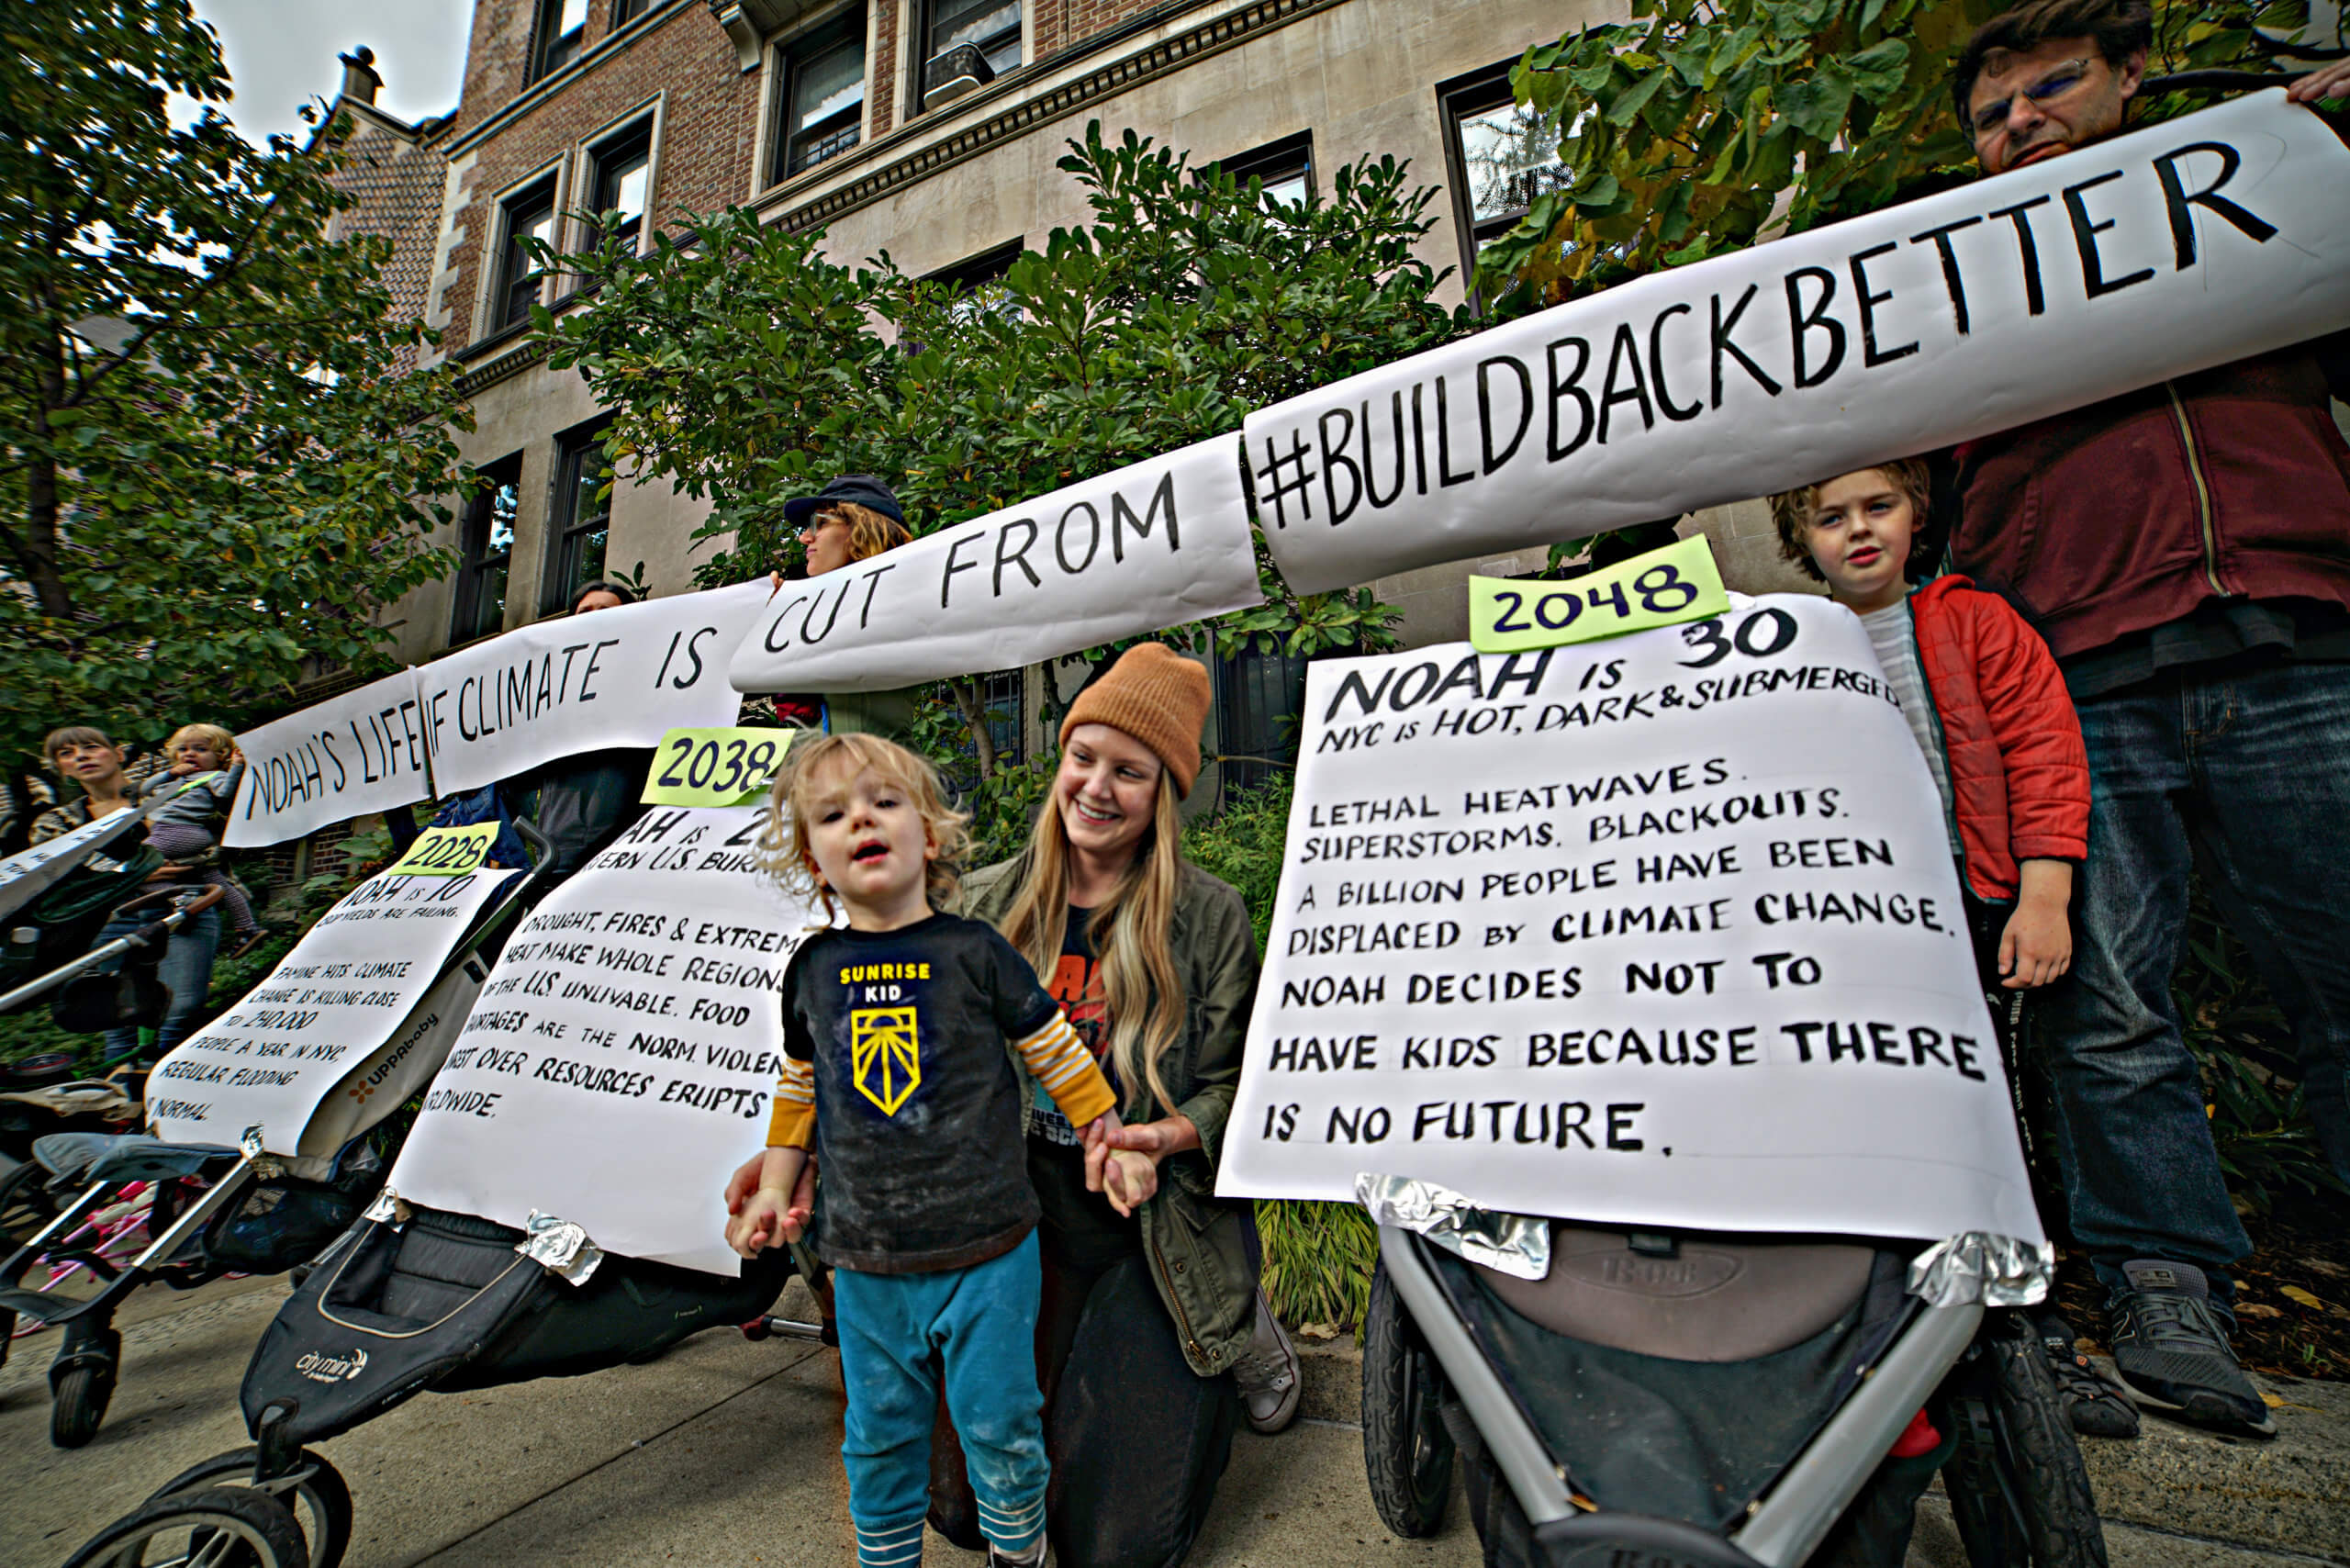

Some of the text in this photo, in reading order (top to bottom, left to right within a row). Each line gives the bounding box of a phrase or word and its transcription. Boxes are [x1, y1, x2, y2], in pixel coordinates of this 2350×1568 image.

[1257, 140, 2277, 528] #BUILDBACKBETTER
[764, 471, 1180, 654] CUT FROM
[1493, 563, 1698, 635] 2048
[1324, 607, 1797, 723] NOAH IS 30
[426, 626, 719, 757] IF CLIMATE IS
[1316, 719, 1385, 754] NYC
[1393, 720, 1421, 743] IS
[1432, 704, 1524, 737] HOT,
[245, 700, 421, 820] NOAH'S LIFE
[657, 736, 777, 793] 2038
[678, 826, 710, 845] IS
[1301, 788, 1850, 863] SUPERSTORMS. BLACKOUTS.
[1311, 793, 1439, 827] LETHAL
[404, 834, 487, 868] 2028
[1297, 839, 1894, 911] A BILLION PEOPLE HAVE BEEN
[380, 907, 405, 919] ARE
[412, 905, 459, 919] FAILING.
[404, 888, 426, 903] IS
[424, 874, 478, 903] 10
[521, 911, 800, 955] DROUGHT, FIRES & EXTREM
[1287, 892, 1956, 957] DISPLACED BY CLIMATE CHANGE.
[273, 961, 413, 980] FAMINE HITS CLIMATE
[505, 942, 783, 993] HEAT MAKE WHOLE REGION
[839, 963, 931, 985] SUNRISE
[1281, 952, 1822, 1008] NOAH DECIDES NOT TO
[248, 988, 401, 1008] CHANGE IS KILLING CLOSE
[496, 977, 521, 996] THE
[562, 980, 677, 1016] UNLIVABLE.
[689, 998, 750, 1027] FOOD
[865, 985, 902, 1002] KID
[222, 1010, 319, 1032] TO 240,000
[188, 1036, 241, 1053] PEOPLE
[235, 1039, 254, 1055] A
[256, 1042, 291, 1058] YEAR
[532, 1020, 568, 1038] ARE
[580, 1028, 617, 1047] THE
[629, 1032, 696, 1063] NORM.
[706, 1045, 783, 1077] VIOLEN
[1269, 1036, 1378, 1072] HAVE
[1402, 1034, 1503, 1069] KIDS
[1528, 1025, 1760, 1068] BECAUSE
[1780, 1021, 1987, 1081] THERE
[159, 1060, 299, 1087] REGULAR FLOODING
[476, 1047, 528, 1075] OVER
[533, 1057, 655, 1098] RESOURCES
[659, 1080, 768, 1119] ERUPTS
[1262, 1102, 1673, 1157] IS NO FUTURE.
